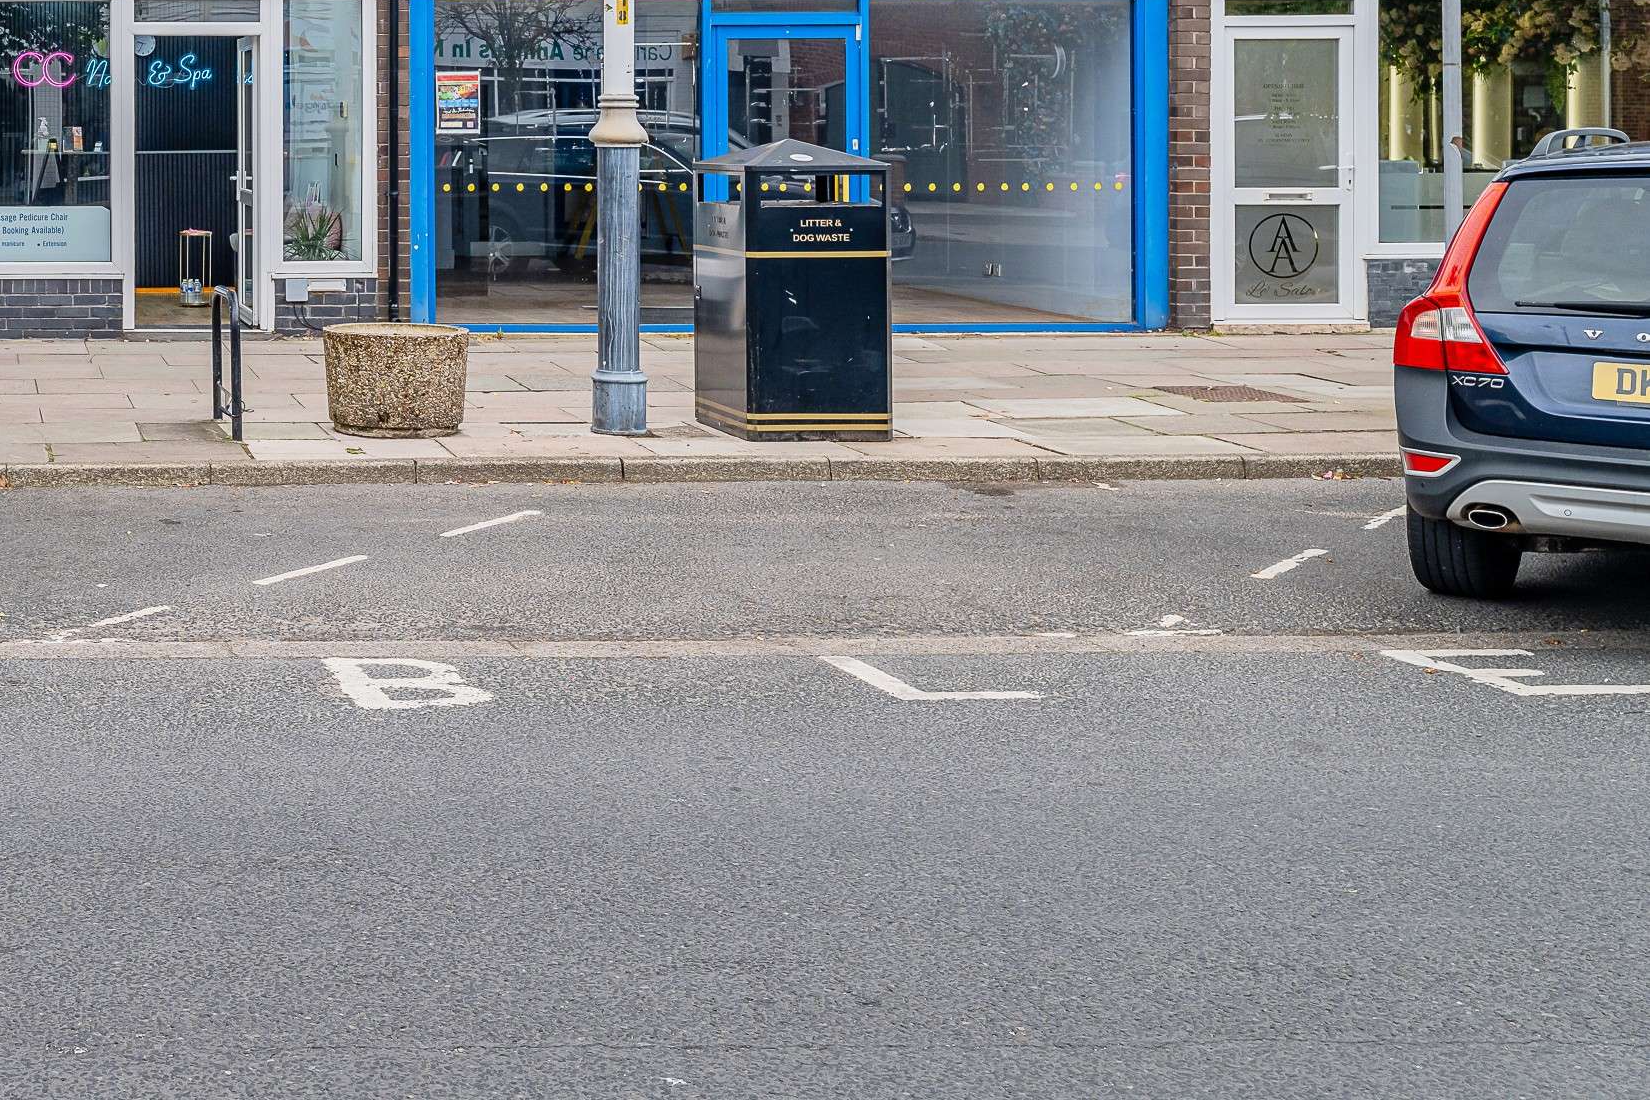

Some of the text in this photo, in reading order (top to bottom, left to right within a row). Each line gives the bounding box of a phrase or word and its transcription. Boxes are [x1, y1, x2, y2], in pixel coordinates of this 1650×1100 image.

[13, 51, 76, 88] CC
[174, 54, 213, 89] Spa
[19, 213, 49, 221] Pedicure
[50, 213, 68, 221] Chair
[800, 219, 842, 227] LITTER &
[2, 226, 29, 236] Booking
[31, 226, 65, 235] Available)
[792, 233, 850, 242] DOG WASTE
[1451, 375, 1505, 389] XC70
